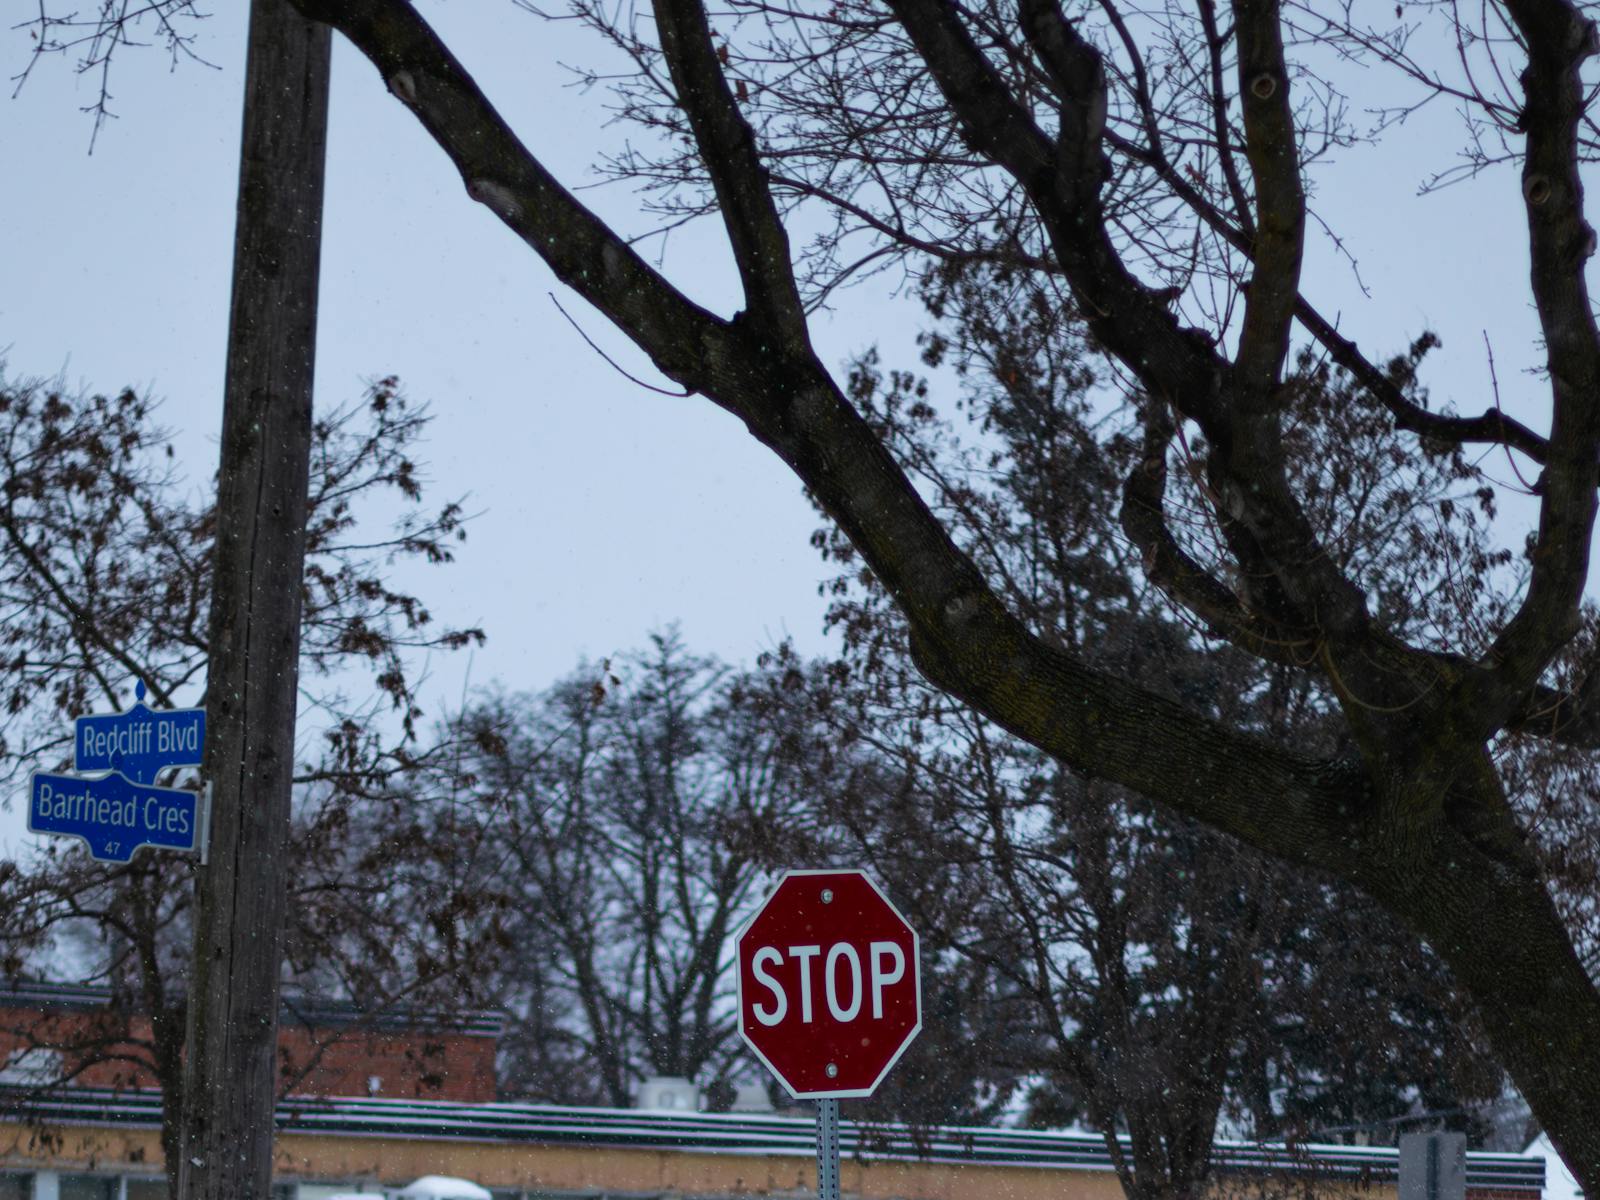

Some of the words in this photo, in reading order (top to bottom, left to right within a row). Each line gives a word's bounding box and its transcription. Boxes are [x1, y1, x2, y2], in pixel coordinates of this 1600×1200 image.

[84, 723, 152, 757] Redcliff
[158, 720, 198, 753] Blvd
[39, 784, 137, 828] Barrhead
[145, 798, 189, 834] Cres
[104, 842, 121, 855] 47
[752, 941, 906, 1027] STOP
